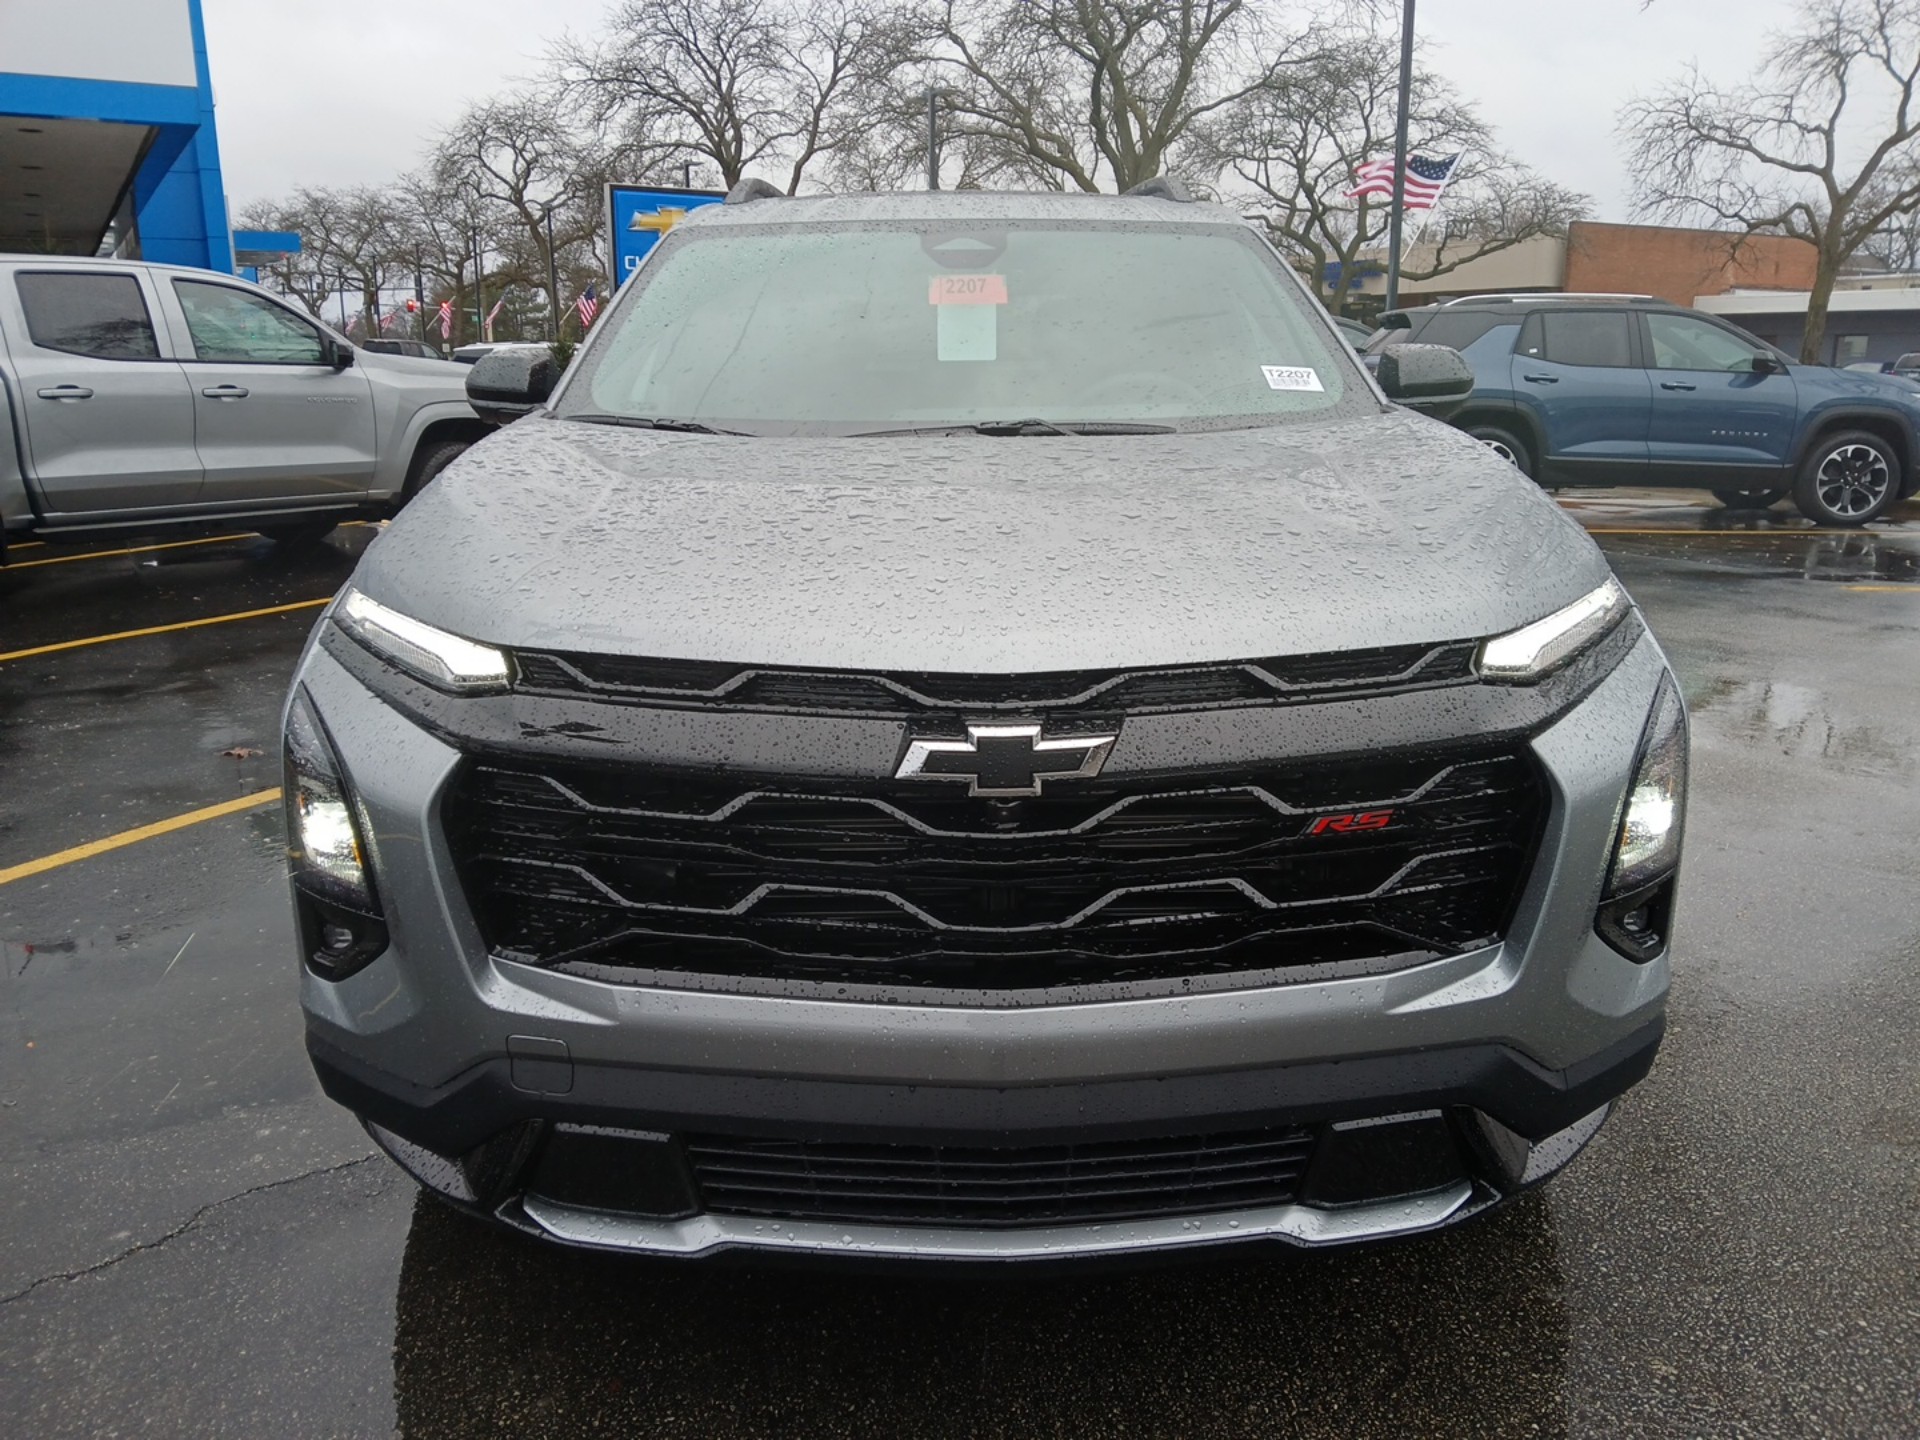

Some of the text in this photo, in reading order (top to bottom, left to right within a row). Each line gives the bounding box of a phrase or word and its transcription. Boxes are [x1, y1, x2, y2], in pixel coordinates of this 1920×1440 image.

[945, 278, 987, 294] 2207
[1265, 368, 1312, 379] T2207
[1308, 808, 1395, 836] RS
